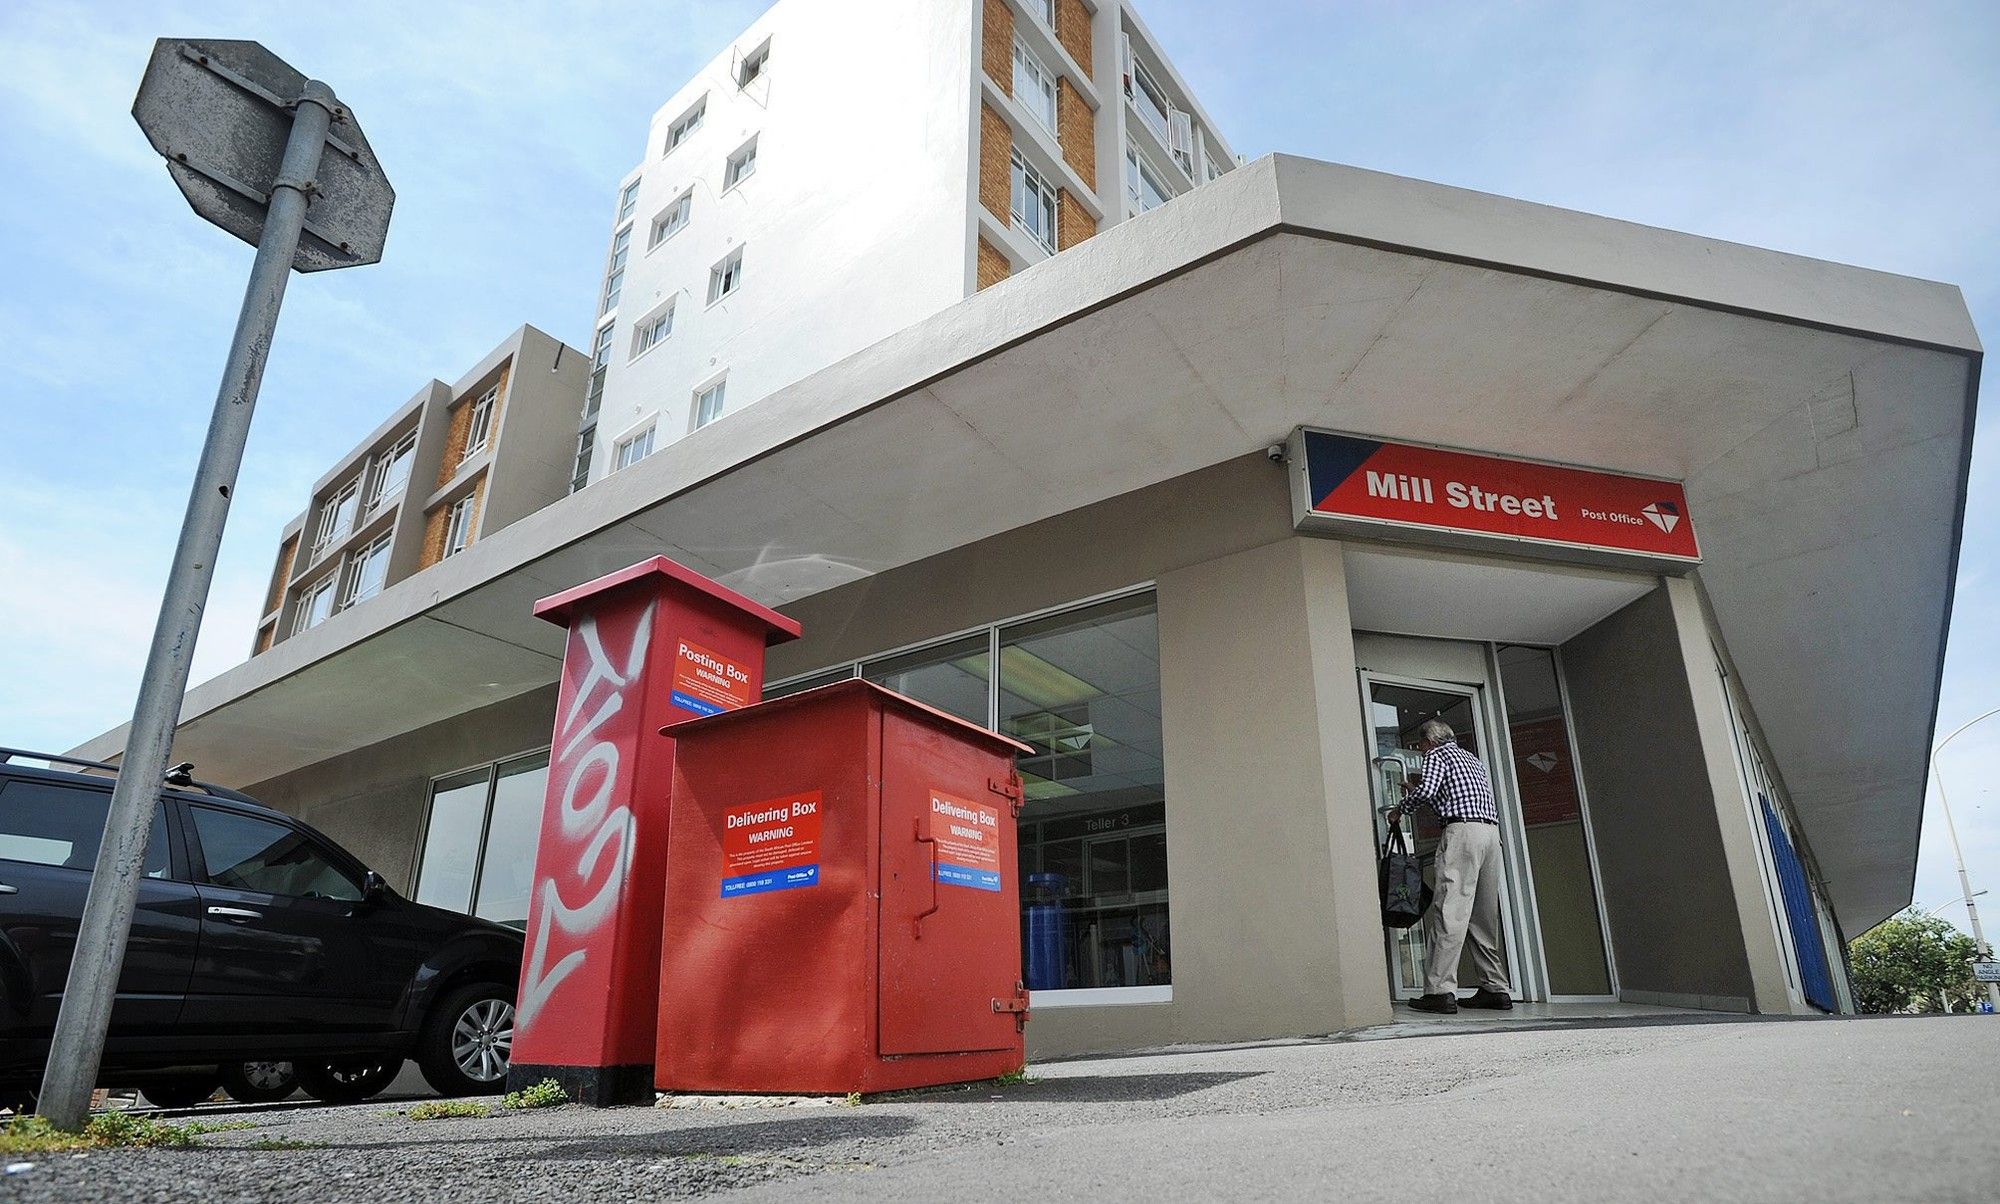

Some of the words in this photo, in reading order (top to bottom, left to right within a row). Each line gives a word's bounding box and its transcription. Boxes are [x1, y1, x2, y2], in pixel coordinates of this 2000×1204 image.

[1366, 471, 1433, 504] Mill
[1446, 481, 1558, 521] Street
[1581, 508, 1607, 521] Post
[1609, 512, 1644, 526] Office
[678, 643, 724, 676] Posting
[726, 663, 749, 684] Box
[695, 667, 731, 689] WARNING
[727, 807, 789, 829] Delivering
[792, 802, 817, 817] Box
[932, 797, 978, 825] Delivering
[979, 810, 996, 827] Box
[748, 826, 794, 844] WARNING
[949, 824, 983, 841] WARNING
[1085, 818, 1115, 831] Teller
